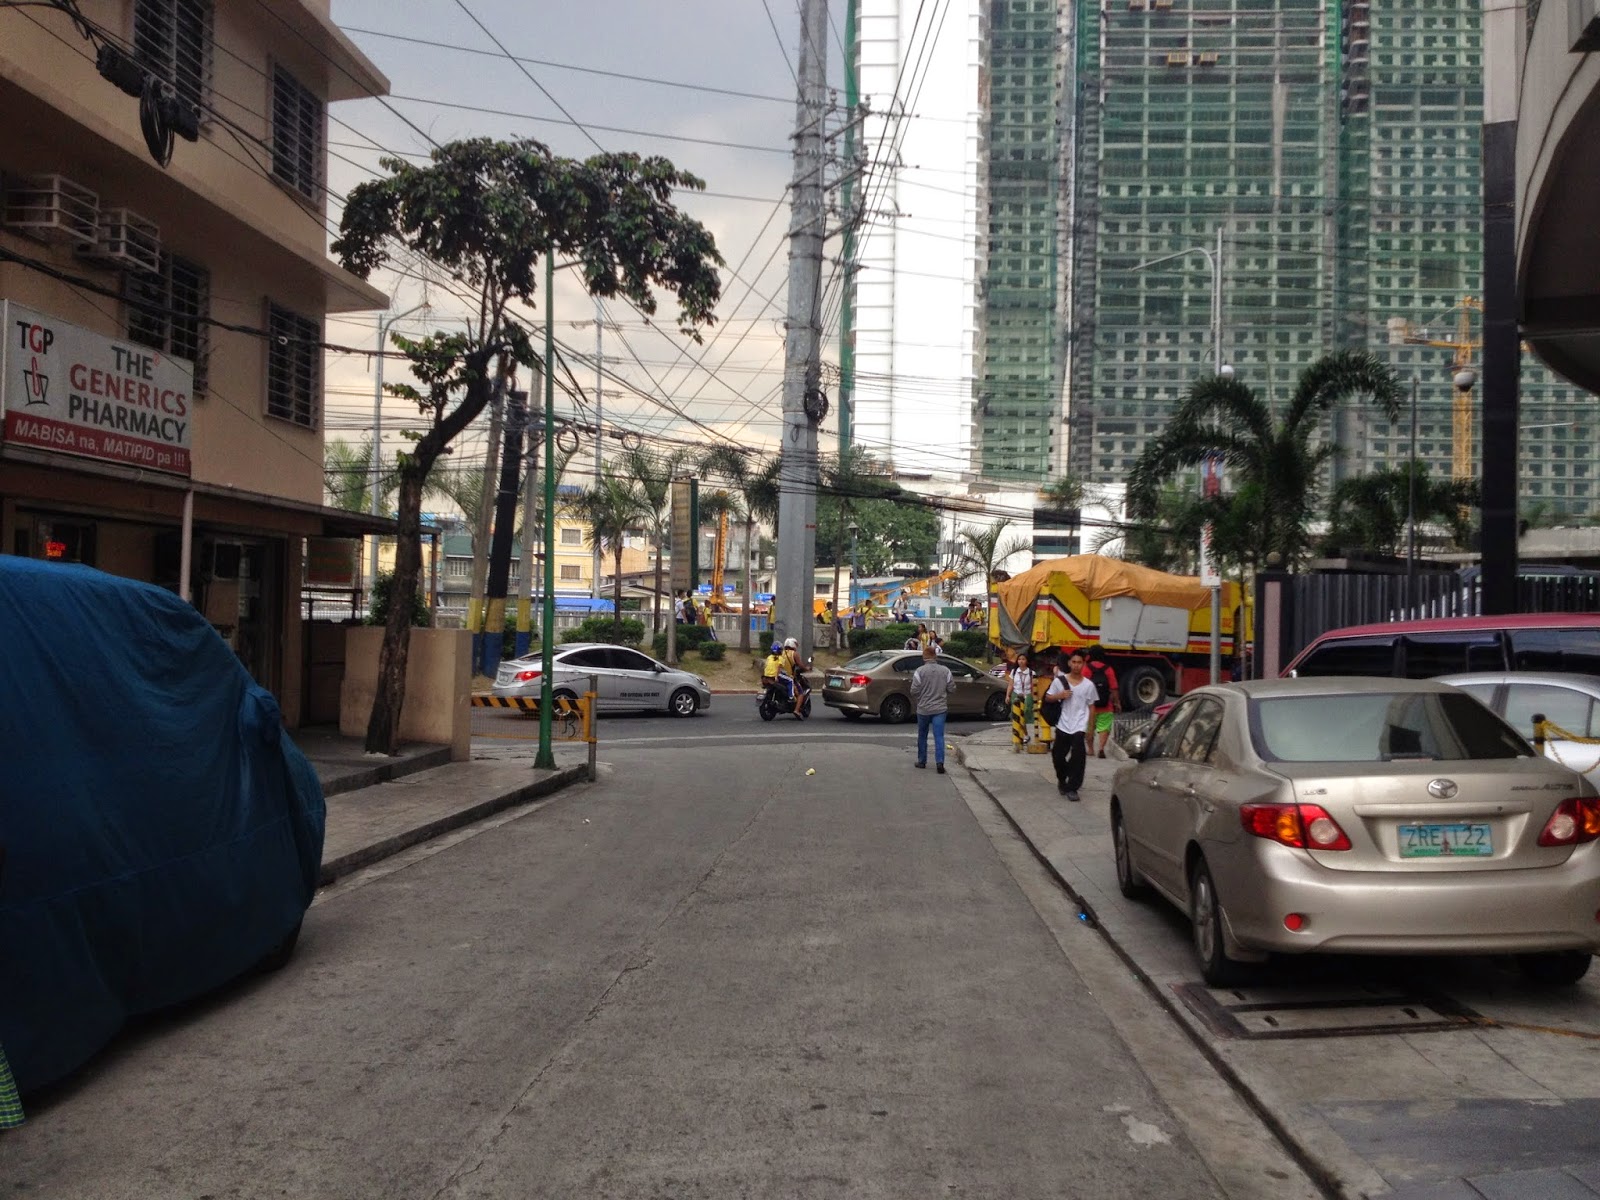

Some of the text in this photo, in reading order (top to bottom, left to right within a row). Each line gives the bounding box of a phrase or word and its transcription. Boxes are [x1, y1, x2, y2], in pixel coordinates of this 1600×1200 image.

[16, 320, 54, 355] TGP
[111, 345, 153, 380] THE
[70, 363, 187, 417] GENERICS
[68, 393, 186, 443] PHARMACY
[15, 419, 75, 446] MABISA
[79, 437, 99, 452] na,
[103, 438, 154, 461] MATIPID
[157, 451, 171, 466] pa
[1406, 828, 1441, 848] ZRE
